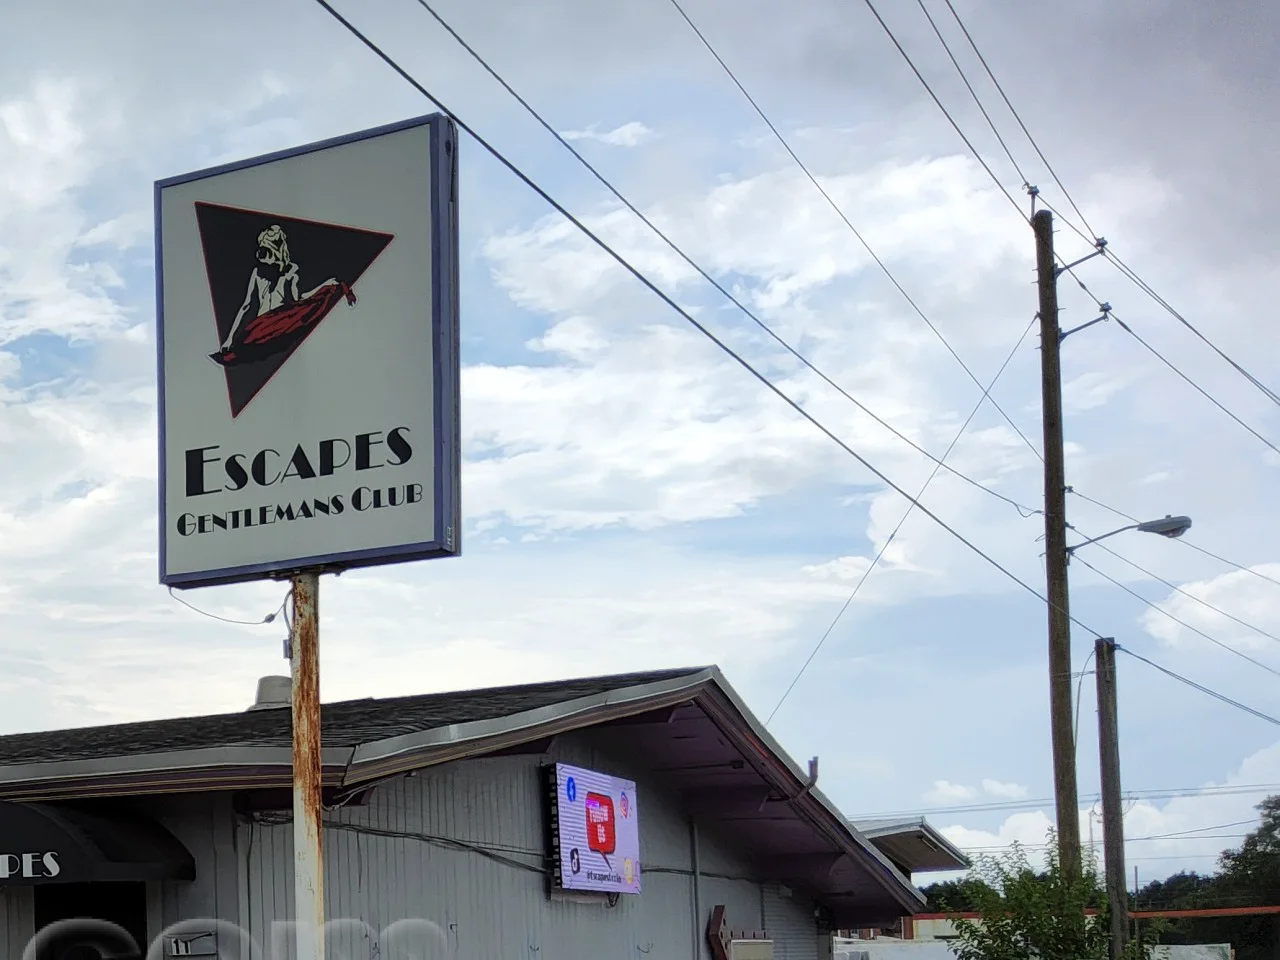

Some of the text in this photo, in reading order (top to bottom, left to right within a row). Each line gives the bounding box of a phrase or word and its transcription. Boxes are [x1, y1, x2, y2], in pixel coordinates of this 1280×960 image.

[185, 426, 413, 497] ESCAPES
[177, 483, 424, 537] GENTLEMANS CLUB
